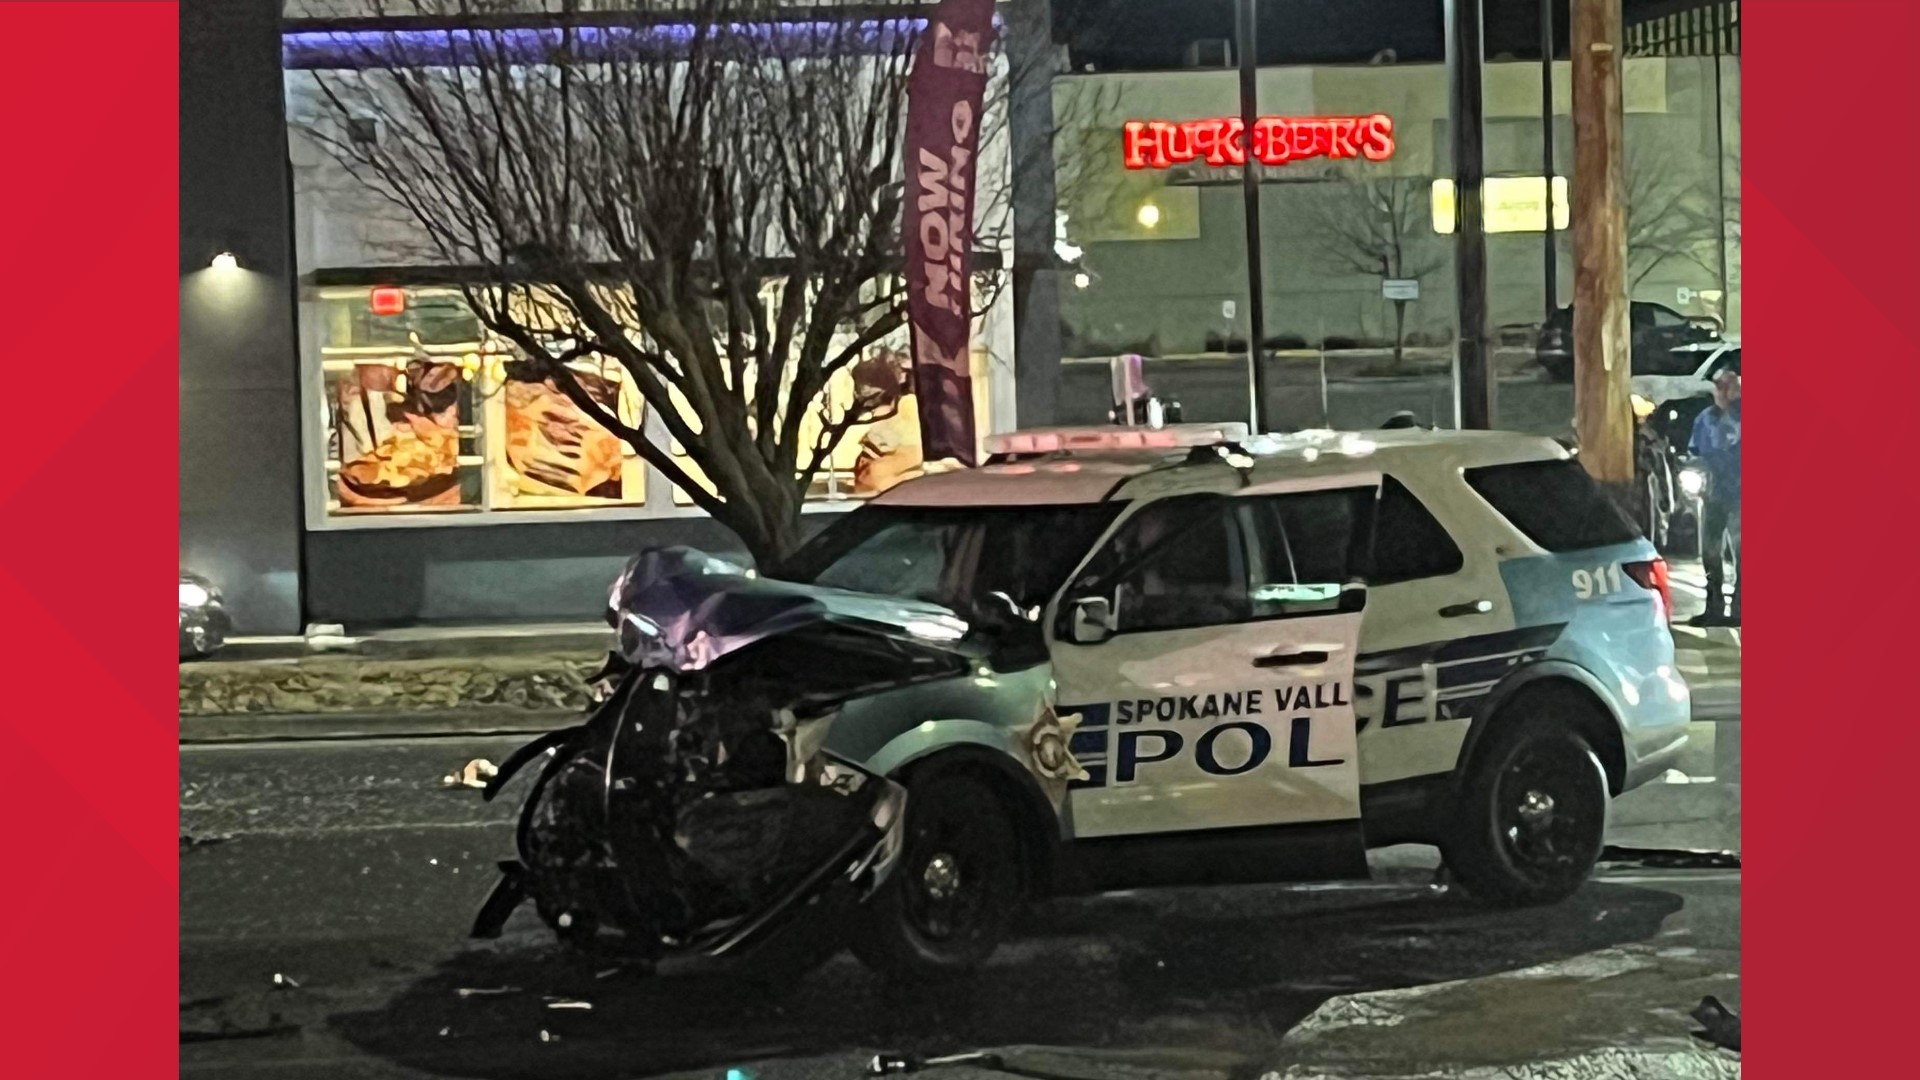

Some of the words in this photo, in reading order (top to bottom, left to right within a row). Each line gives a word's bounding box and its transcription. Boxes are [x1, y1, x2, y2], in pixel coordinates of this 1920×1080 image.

[918, 147, 949, 309] NOW
[1572, 560, 1622, 600] 911
[1116, 690, 1263, 725] SPOKANE
[1275, 682, 1349, 712] VALL
[1115, 717, 1346, 782] POL
